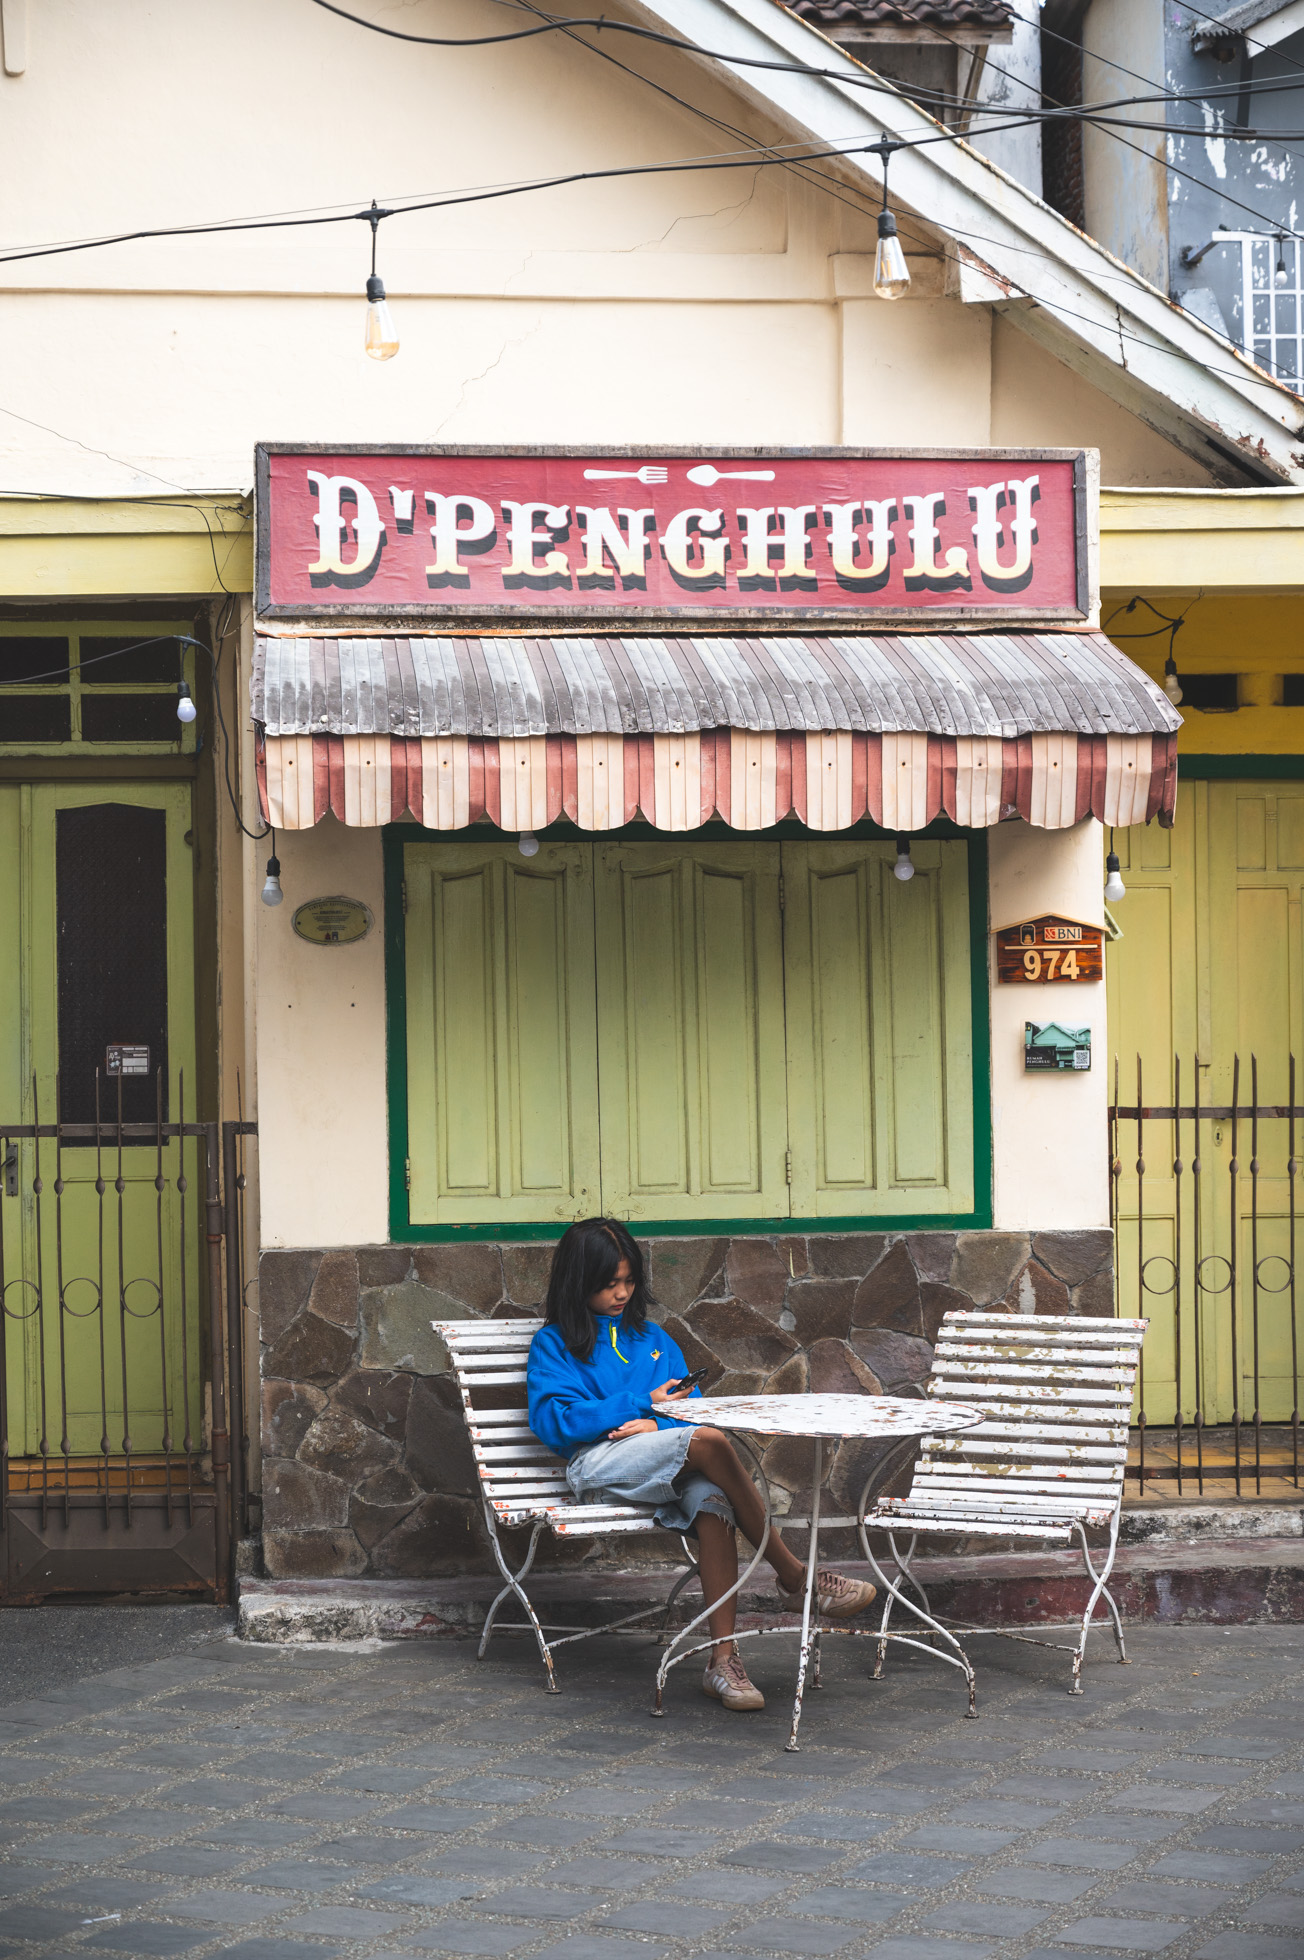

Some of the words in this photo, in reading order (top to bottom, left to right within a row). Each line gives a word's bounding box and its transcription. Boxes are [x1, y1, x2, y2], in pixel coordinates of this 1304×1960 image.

[306, 469, 1041, 592] D'PENGHULU
[1057, 928, 1082, 940] BNI
[1023, 950, 1080, 980] 974
